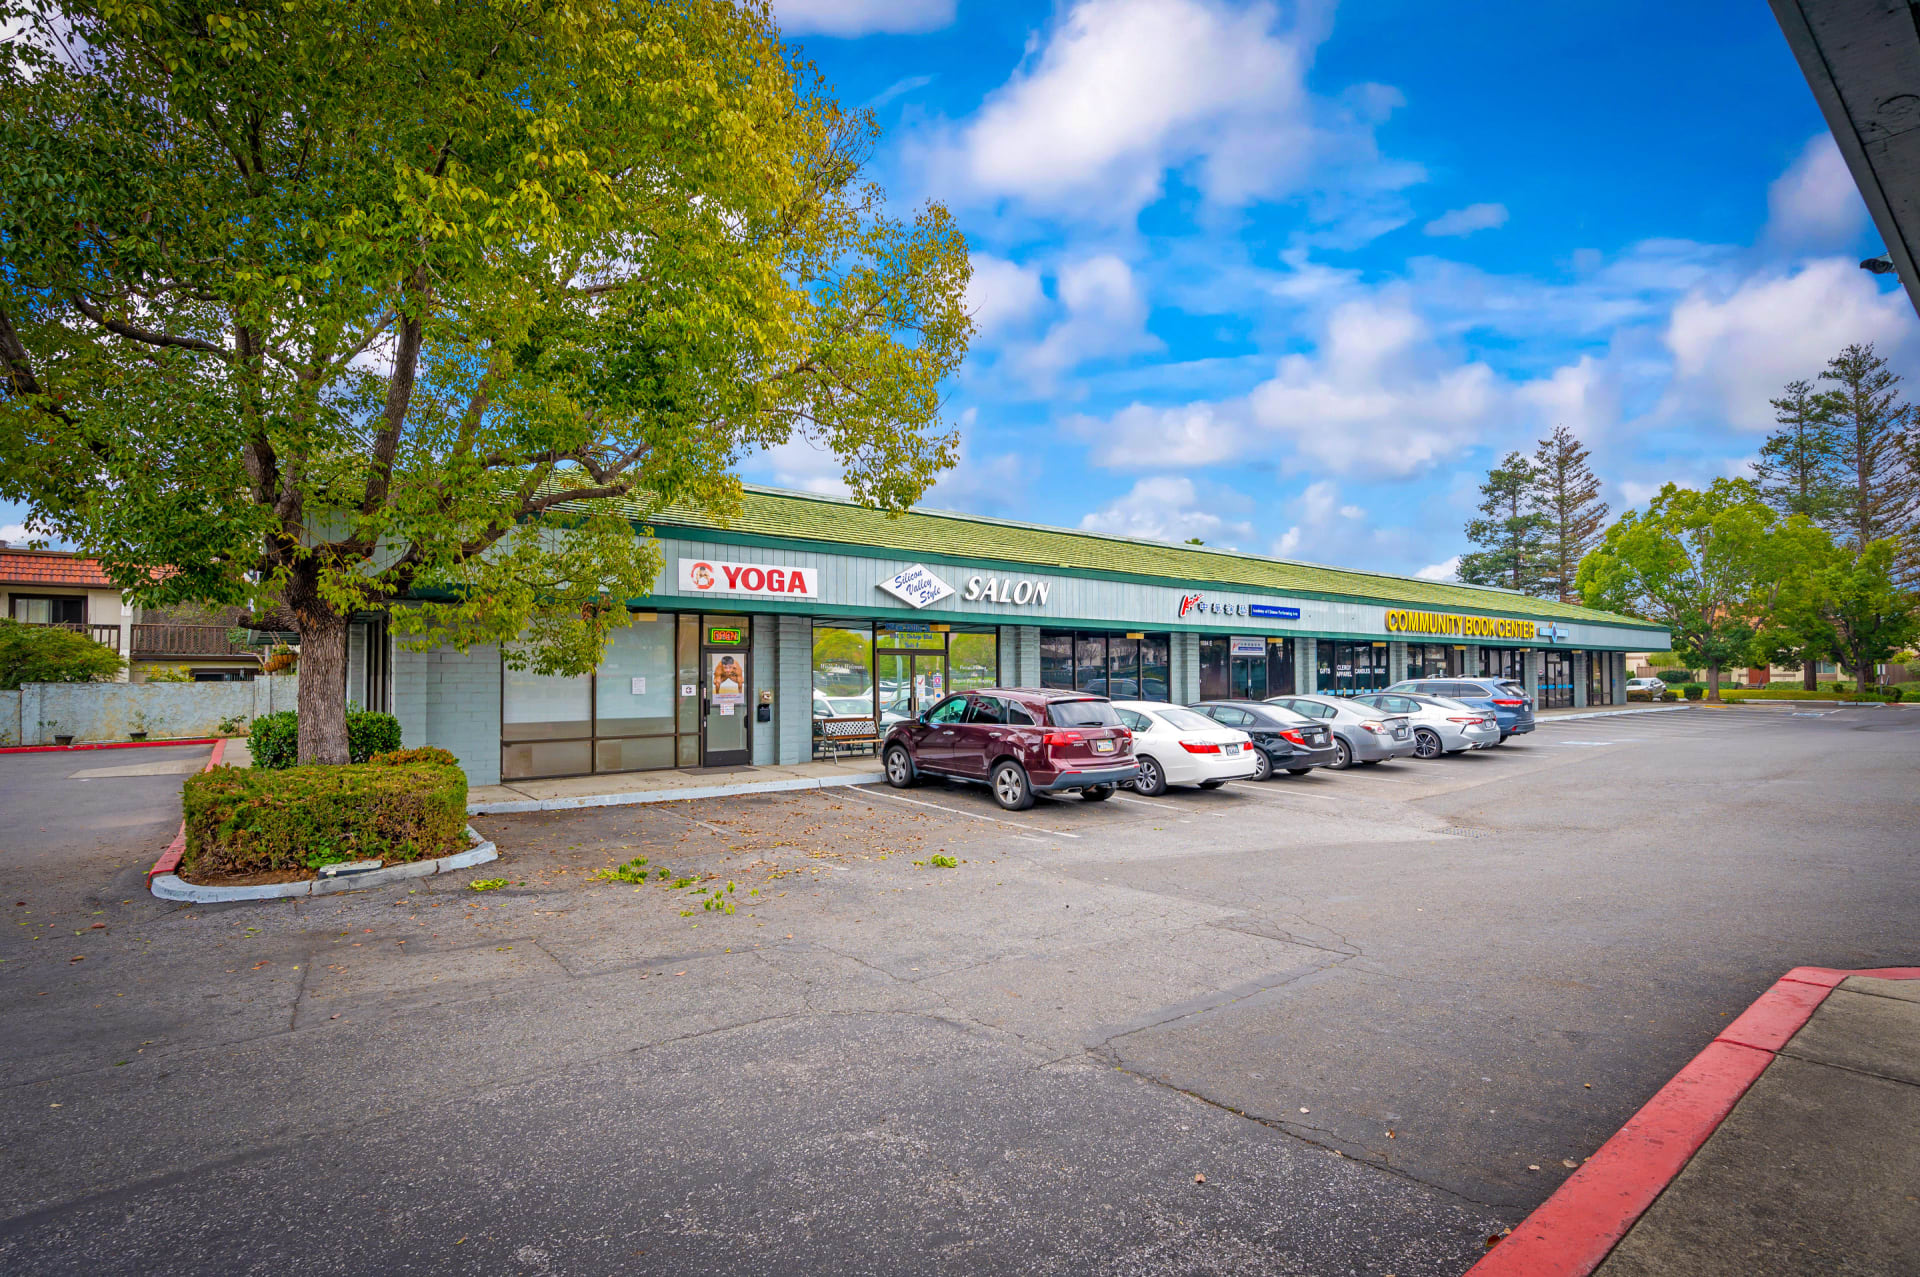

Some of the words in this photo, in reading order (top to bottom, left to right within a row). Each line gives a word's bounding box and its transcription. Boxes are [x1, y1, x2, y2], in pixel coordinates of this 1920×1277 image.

[721, 565, 808, 594] YOGA
[894, 569, 923, 589] Silicon
[905, 577, 933, 596] Valley
[919, 585, 942, 604] Style
[963, 575, 1051, 605] SALON
[1386, 610, 1463, 635] COMMUNITY
[1465, 616, 1496, 637] BOOK
[1497, 619, 1535, 639] CENTER
[713, 630, 738, 641] OPEN
